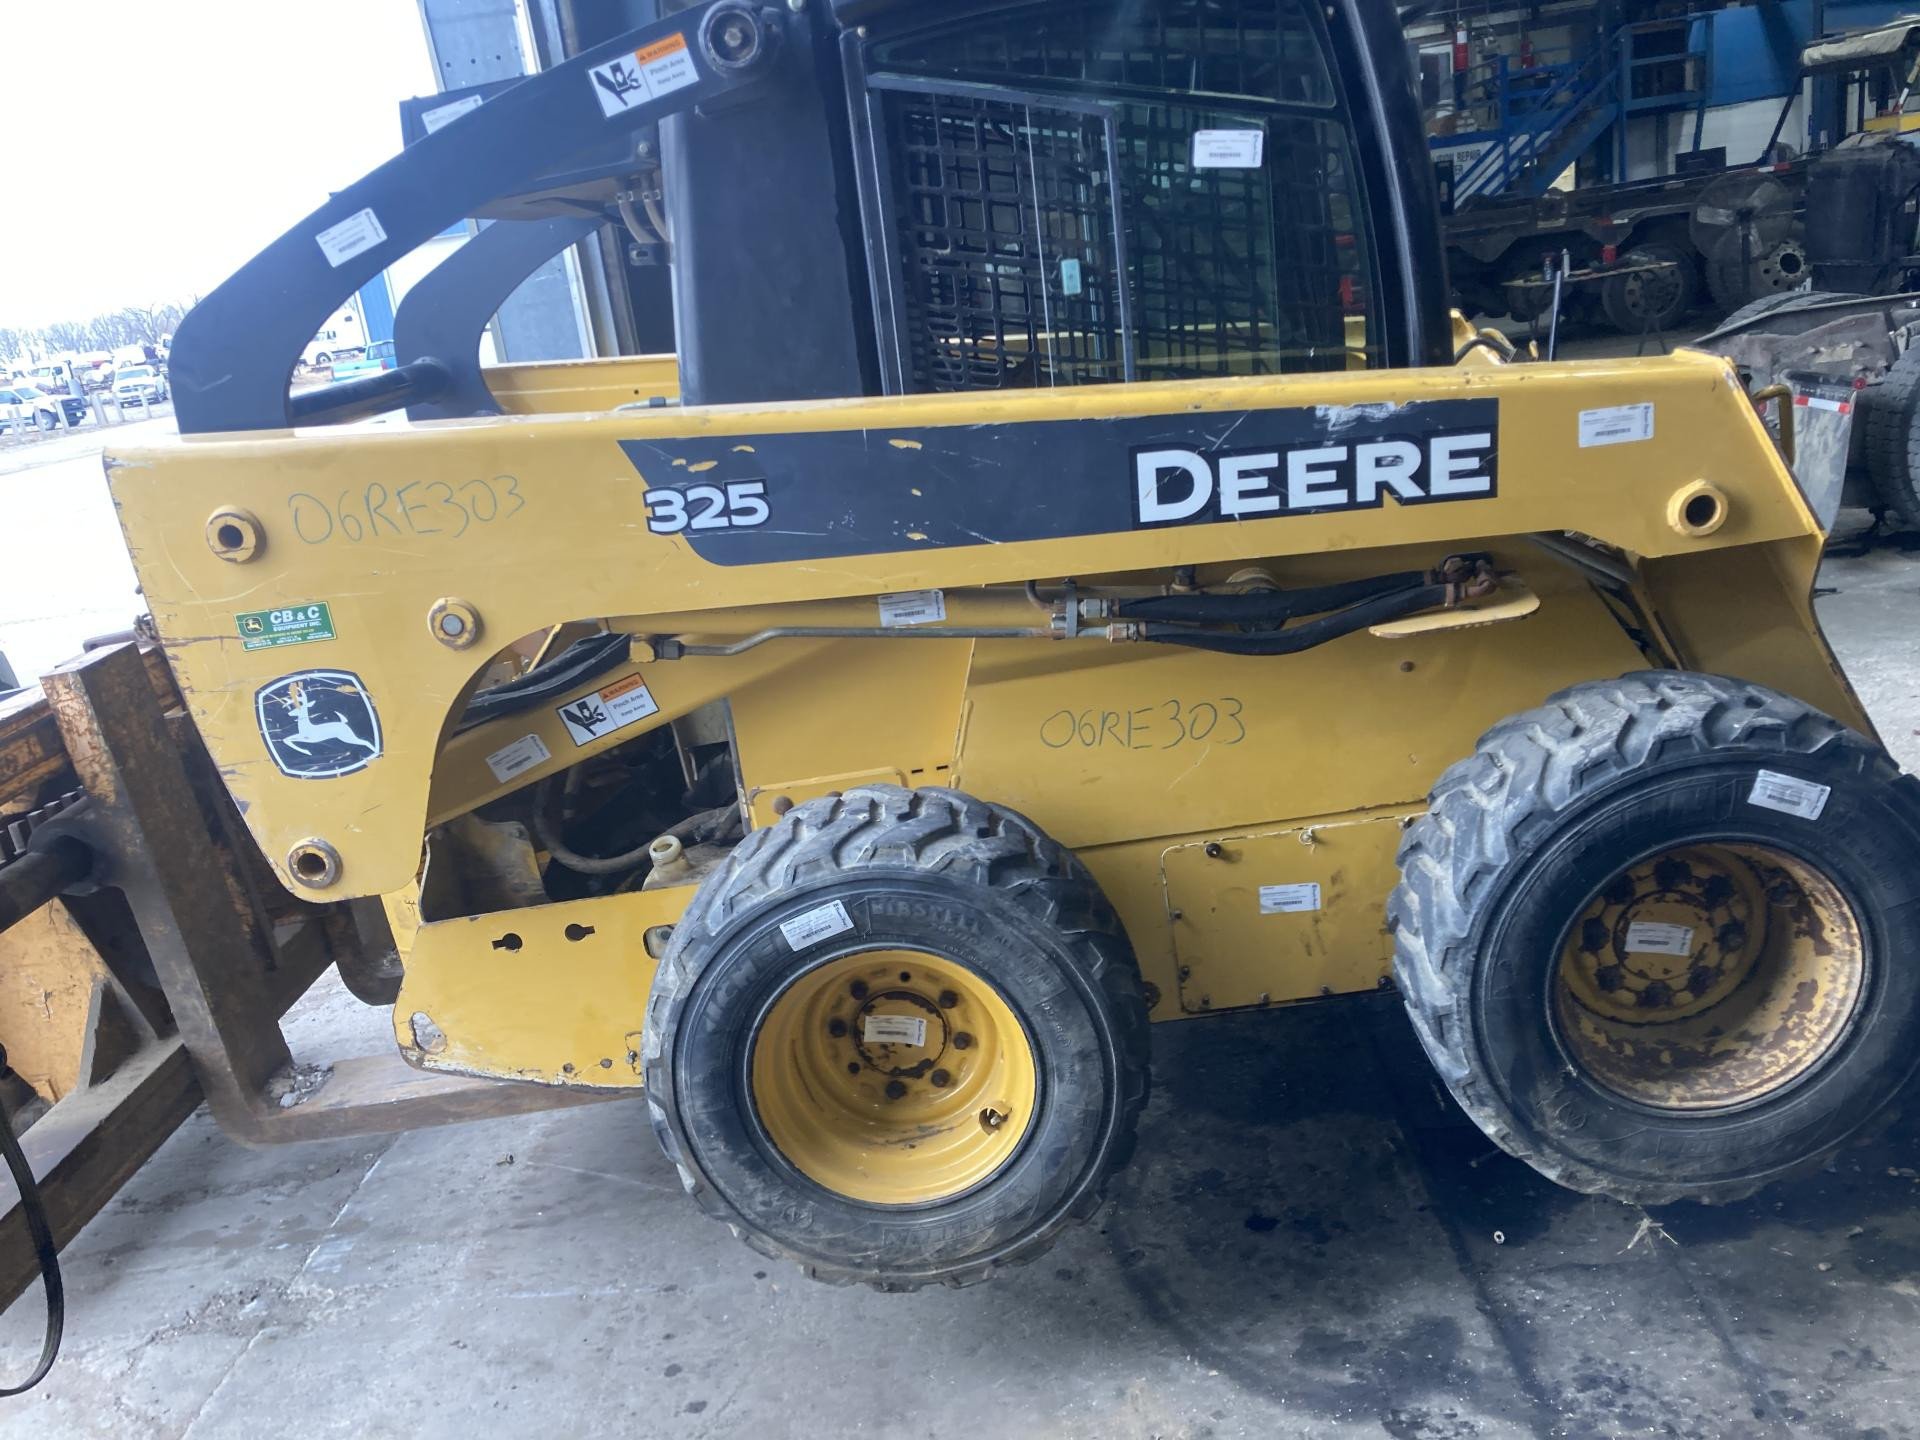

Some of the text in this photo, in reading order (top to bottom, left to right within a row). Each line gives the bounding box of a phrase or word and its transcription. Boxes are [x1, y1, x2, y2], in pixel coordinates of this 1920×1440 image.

[648, 40, 681, 56] WARNING
[650, 58, 685, 76] Pinch Area
[1135, 432, 1492, 523] DEERE
[644, 480, 770, 533] 325
[270, 606, 320, 623] CB & C
[272, 623, 308, 632] EQUIPMENT
[613, 694, 643, 710] Pinch Area
